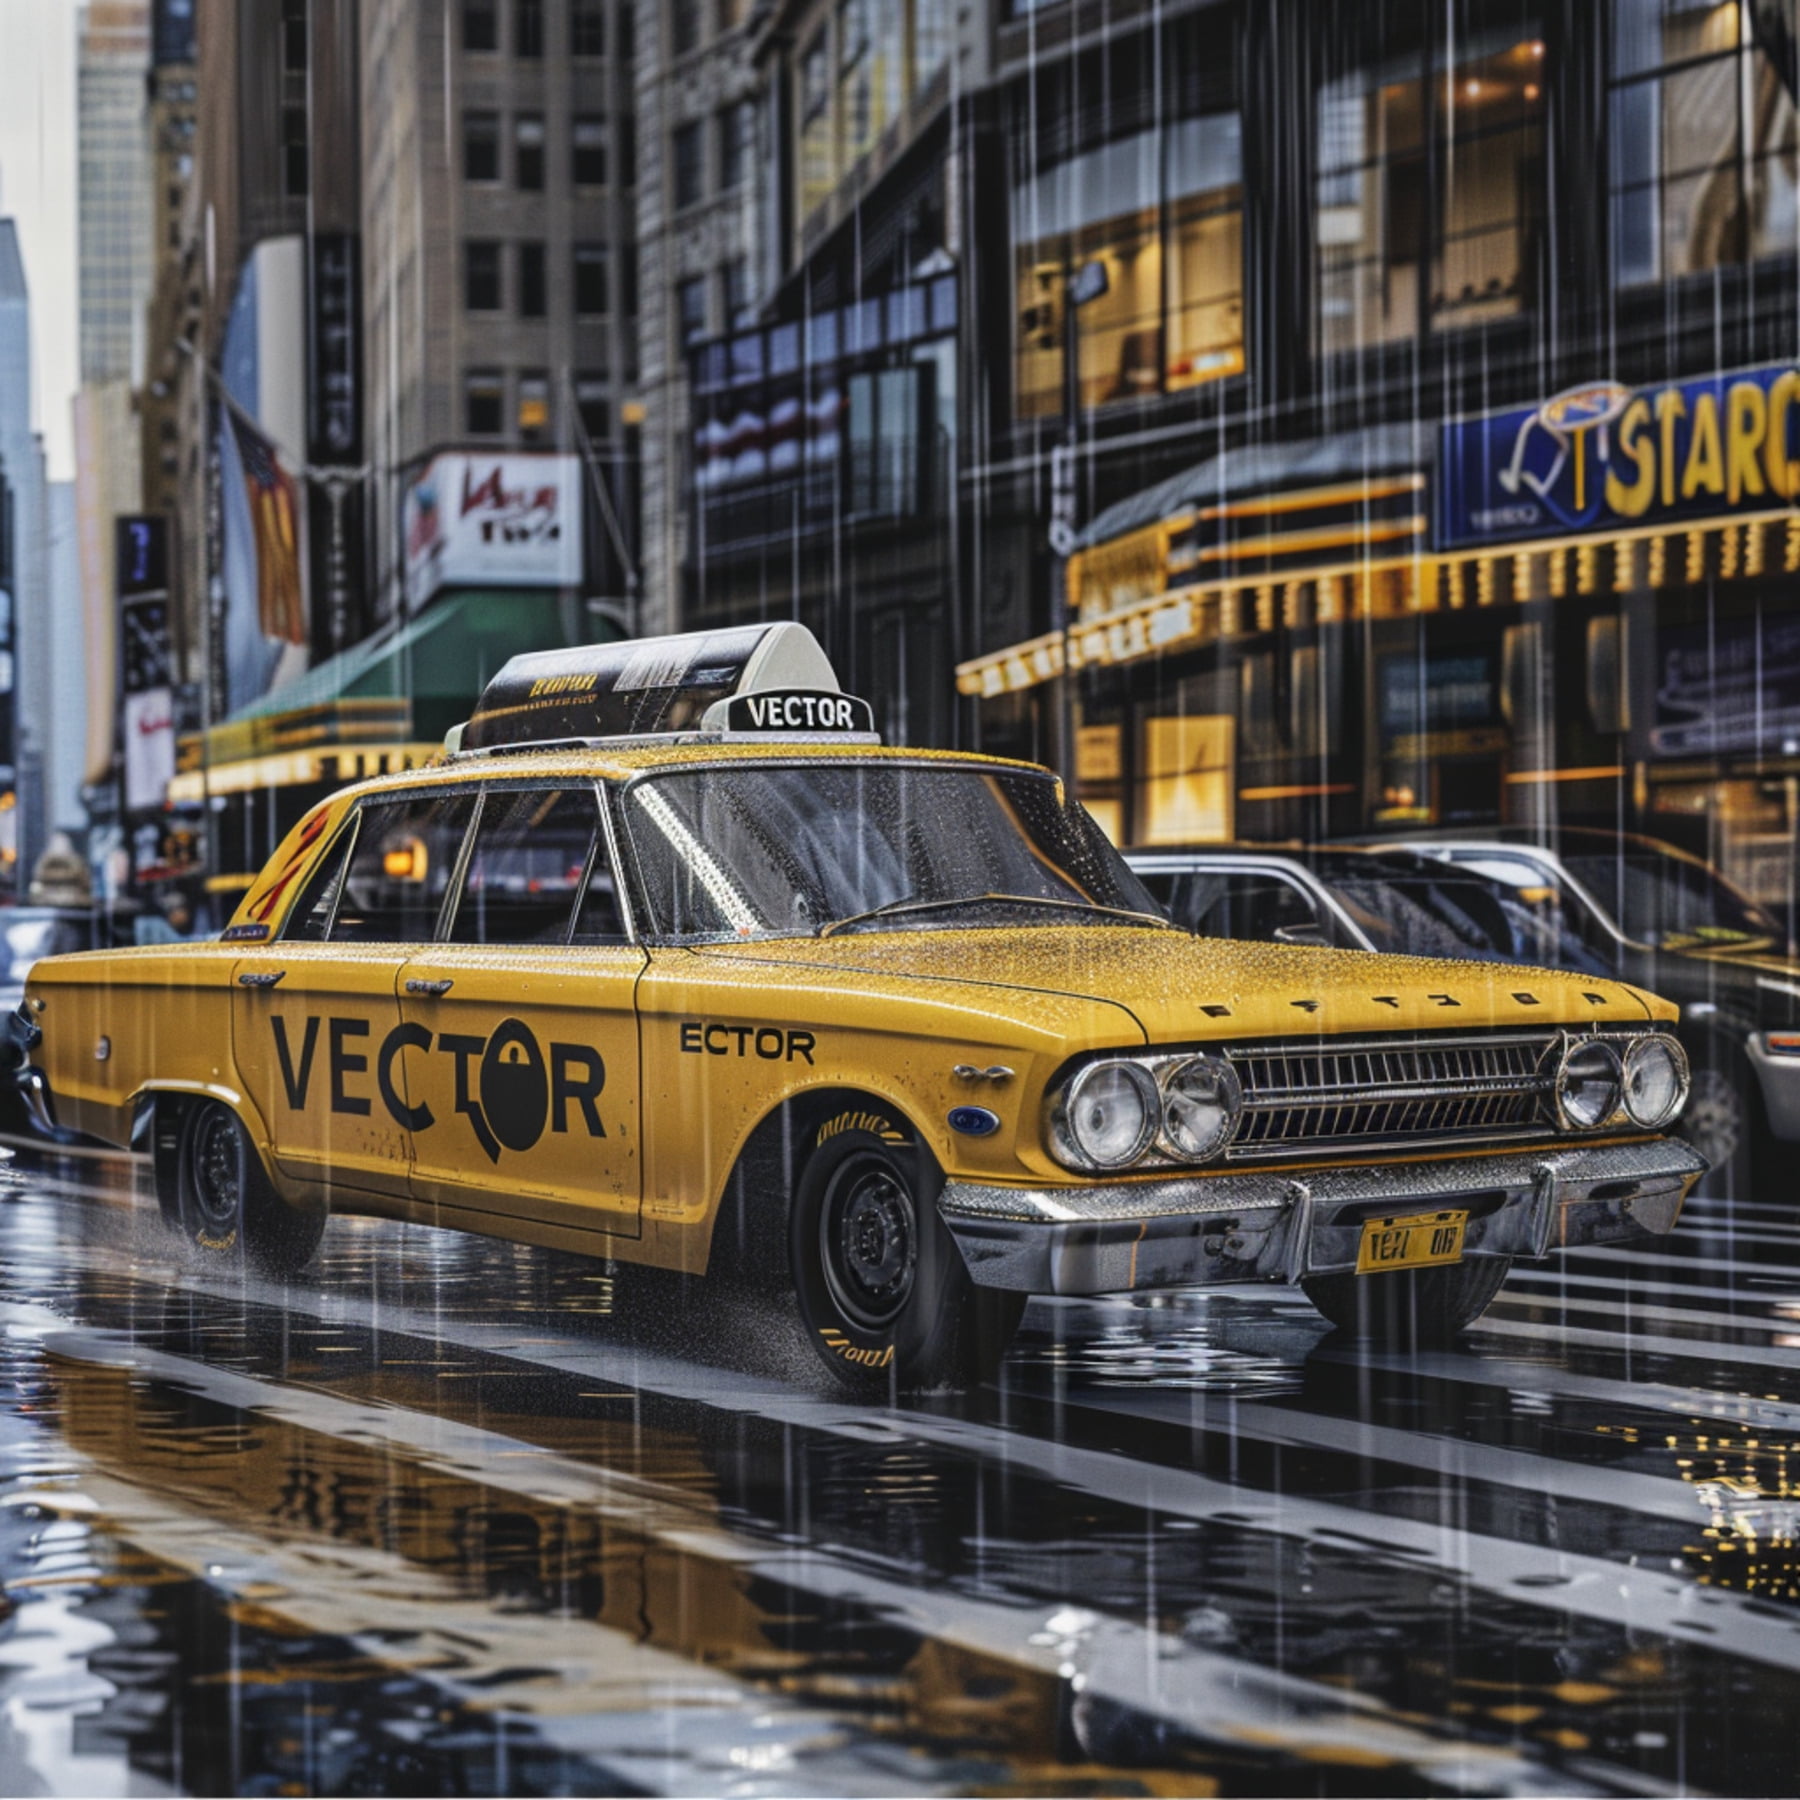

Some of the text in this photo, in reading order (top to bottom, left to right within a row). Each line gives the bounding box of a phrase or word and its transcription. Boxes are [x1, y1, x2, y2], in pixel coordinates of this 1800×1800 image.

[747, 696, 854, 729] VECTOR
[680, 1022, 816, 1066] ECTOR
[269, 1014, 607, 1160] VECTOR
